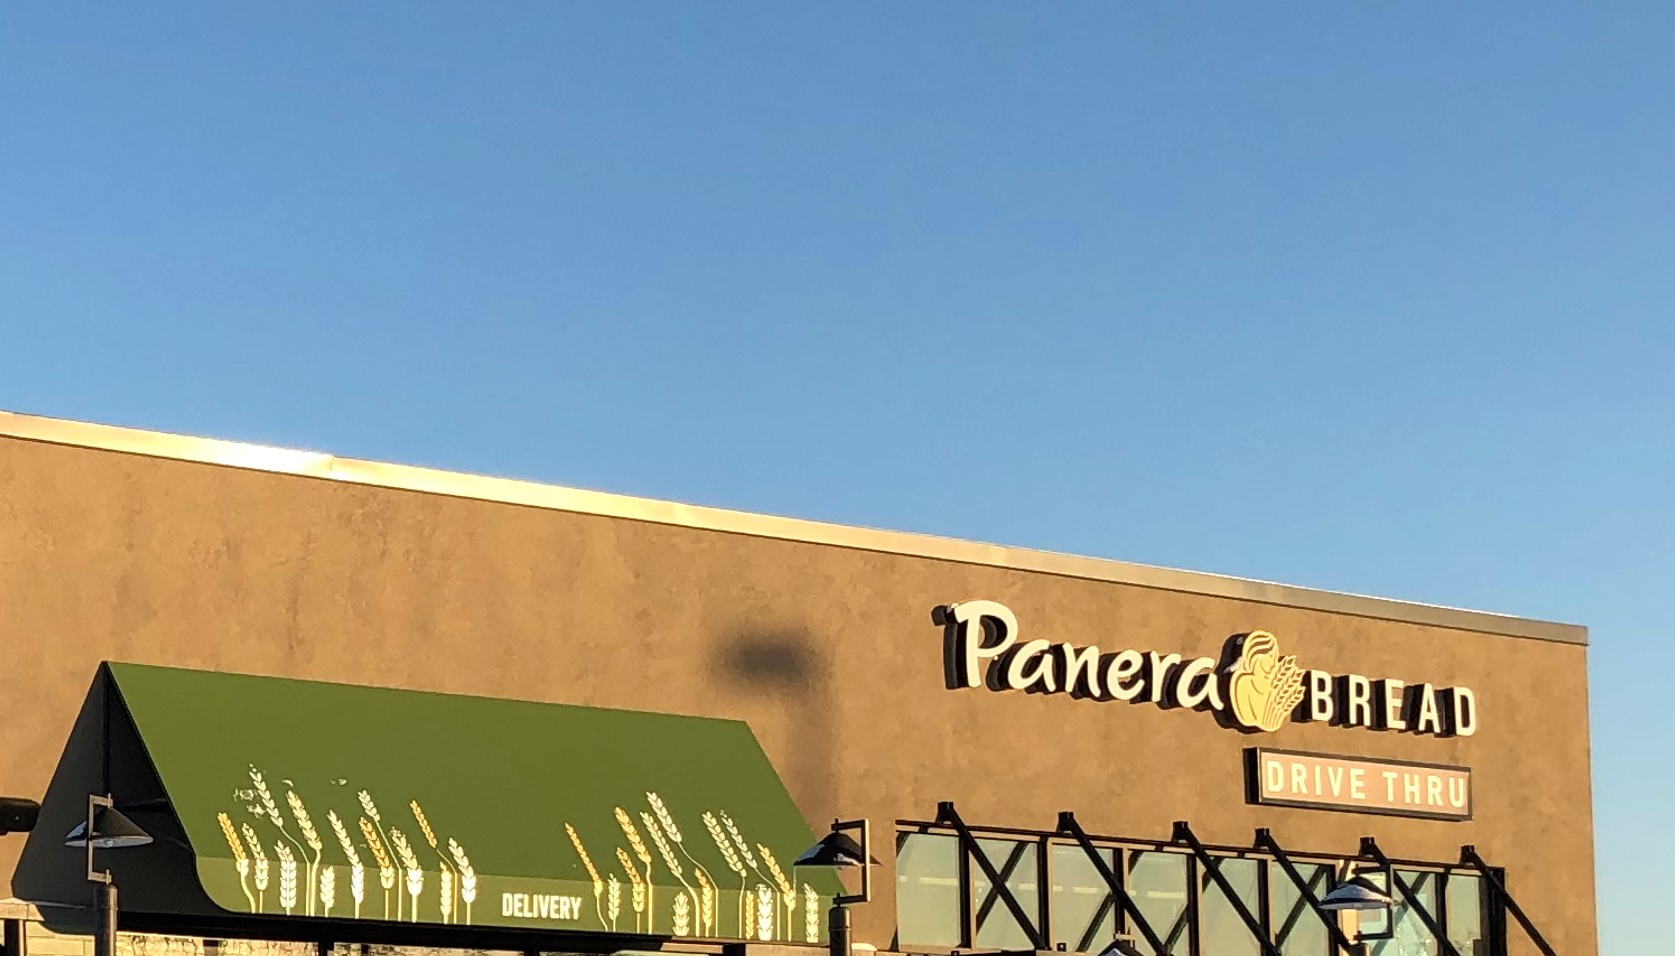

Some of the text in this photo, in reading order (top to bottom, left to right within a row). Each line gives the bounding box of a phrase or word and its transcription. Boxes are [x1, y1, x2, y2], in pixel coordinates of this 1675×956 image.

[951, 599, 1477, 738] Panera BREAD
[1266, 760, 1466, 808] DRIVE THRU
[501, 892, 582, 920] DELIVERY
